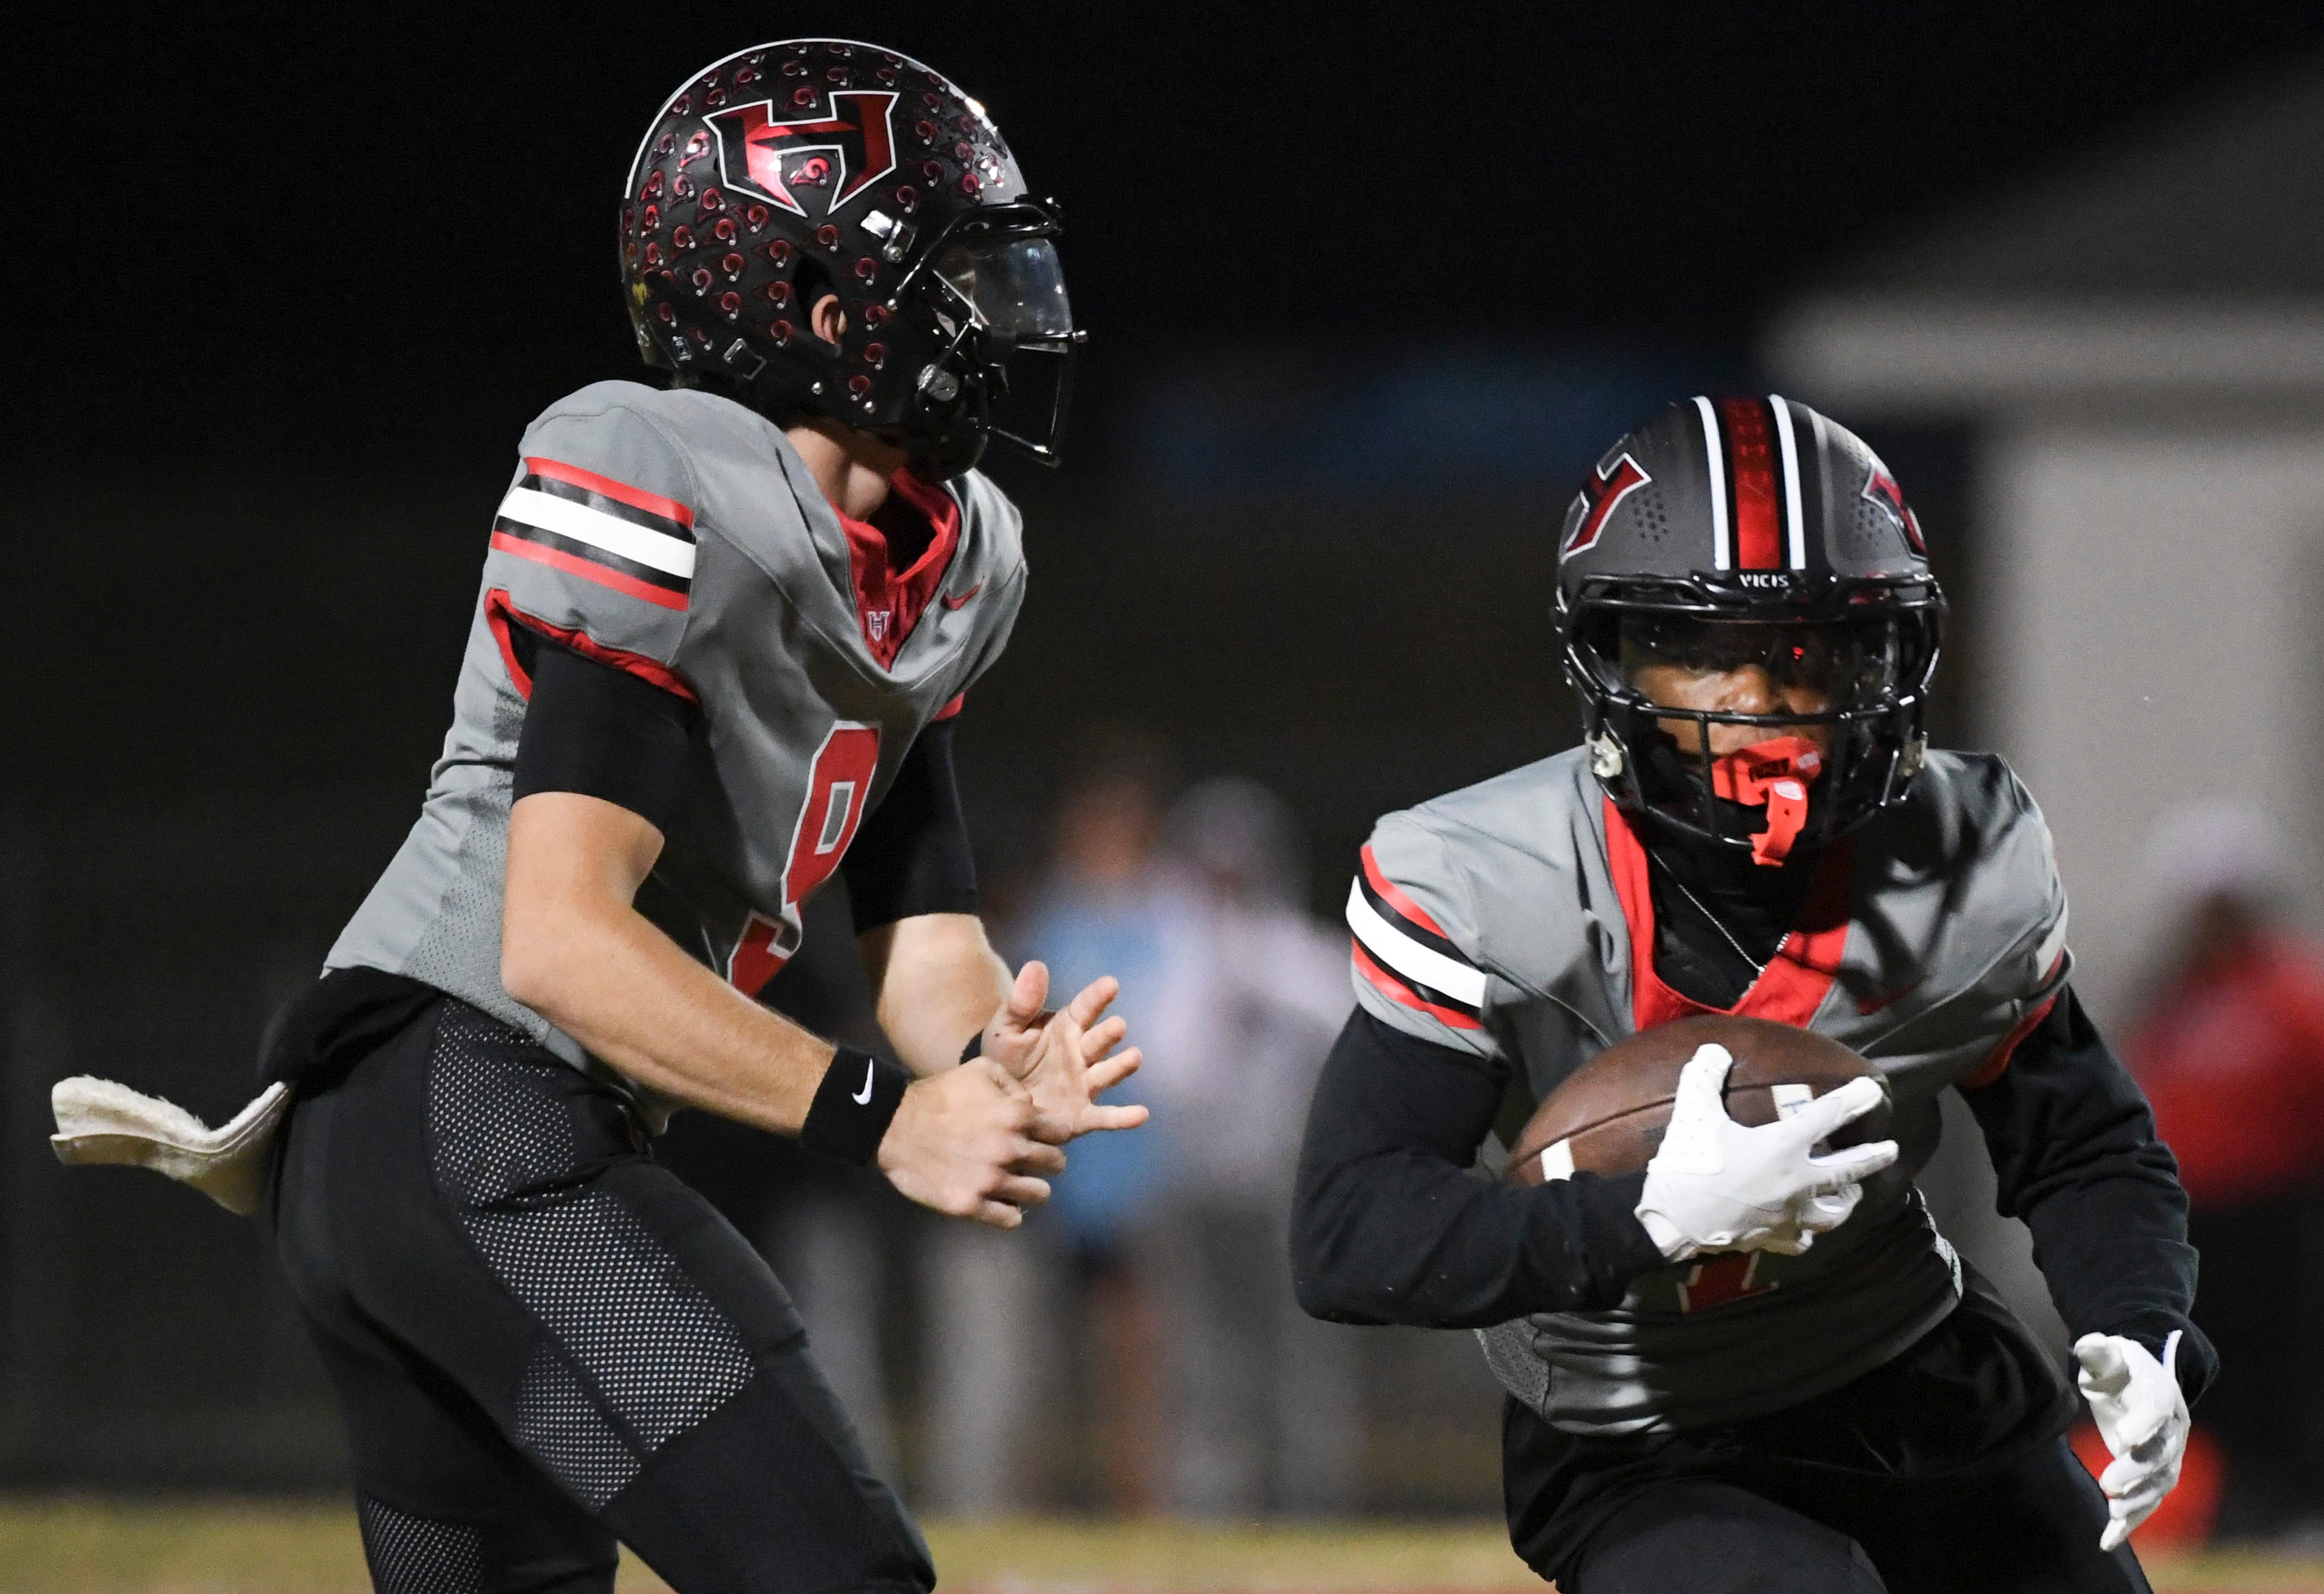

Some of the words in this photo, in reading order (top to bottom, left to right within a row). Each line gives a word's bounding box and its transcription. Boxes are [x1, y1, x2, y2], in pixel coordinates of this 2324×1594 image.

[703, 91, 900, 217] H
[1739, 574, 1789, 588] VICIS
[868, 611, 891, 642] H
[726, 719, 882, 998] 9
